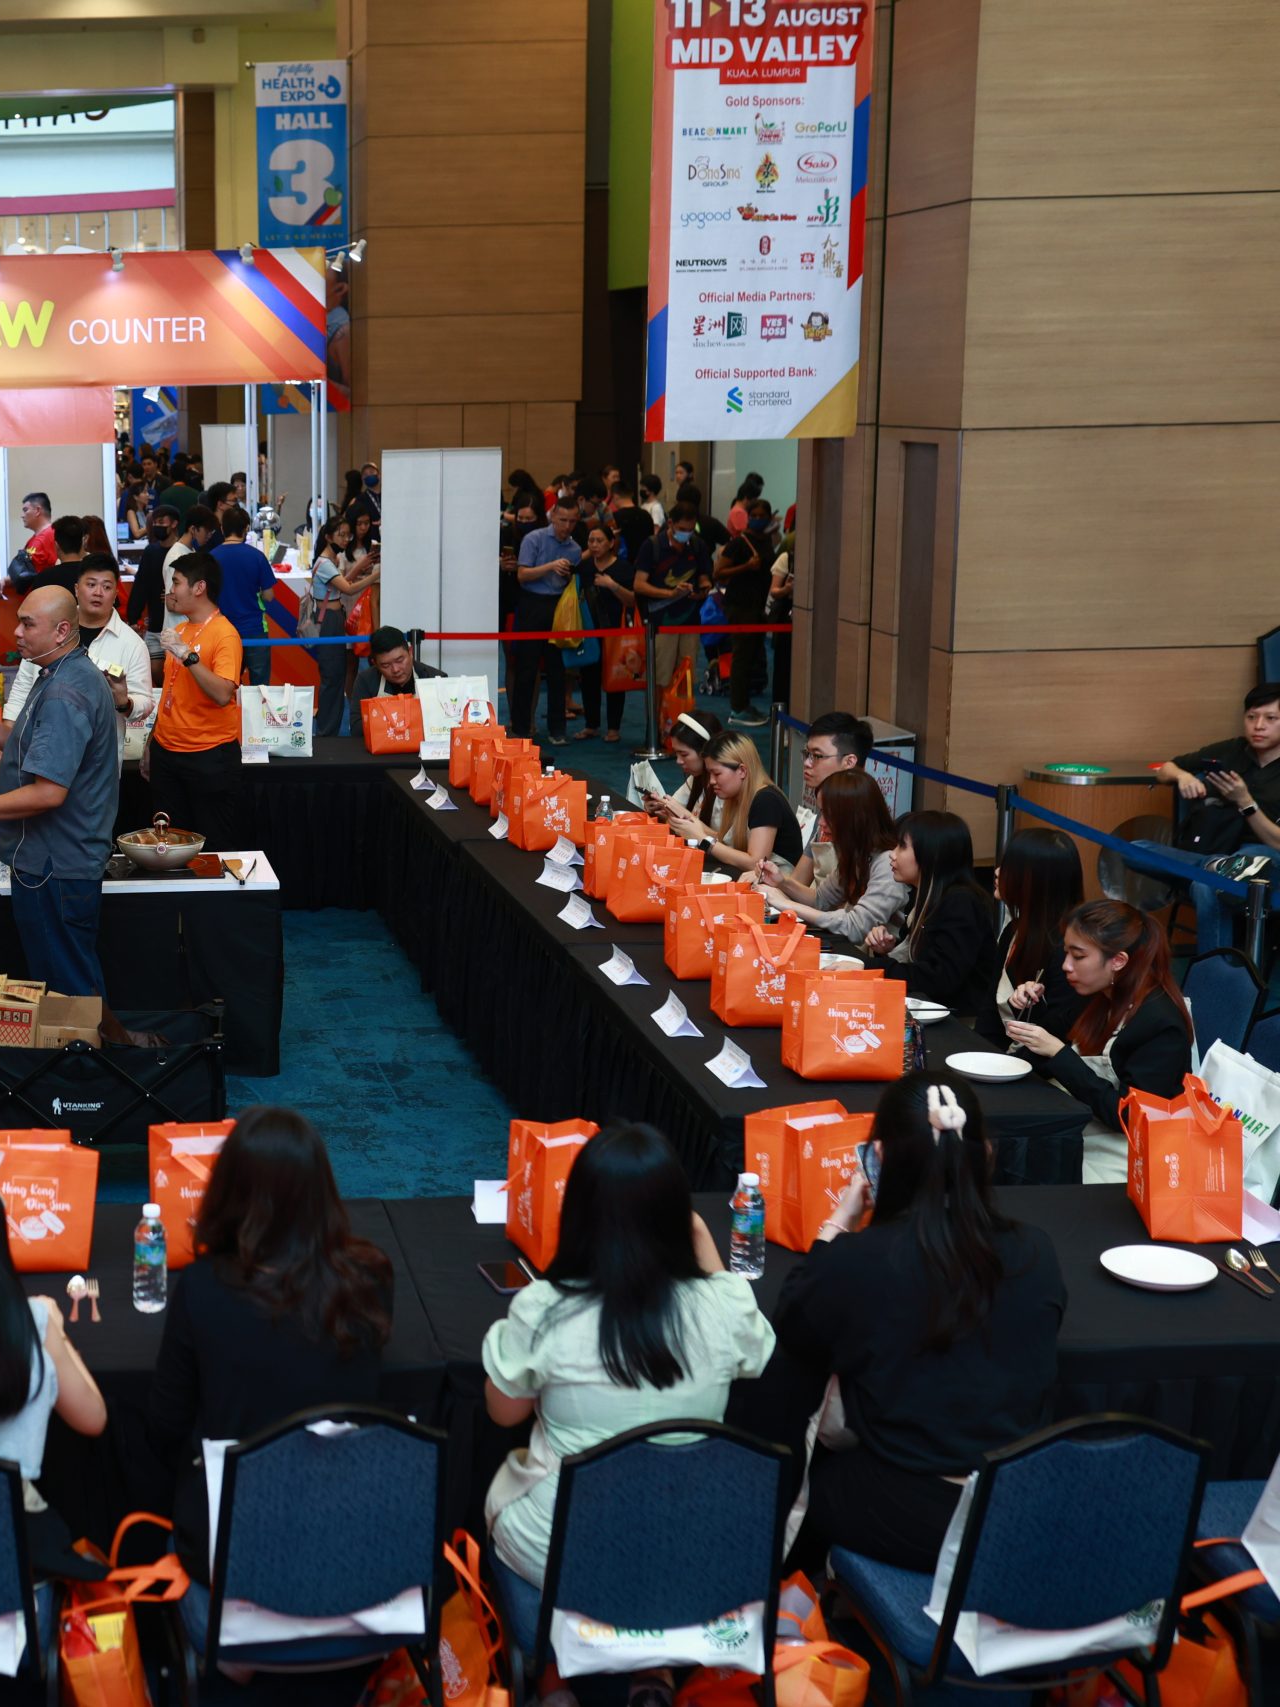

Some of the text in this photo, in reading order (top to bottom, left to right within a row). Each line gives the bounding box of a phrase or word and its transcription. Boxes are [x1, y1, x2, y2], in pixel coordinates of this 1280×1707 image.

[674, 0, 862, 28] 11 13 AUGUST
[671, 35, 858, 64] MID VALLEY
[726, 68, 801, 78] KUALA LUMPUR
[261, 78, 315, 90] HEALTH
[280, 91, 316, 102] EXPO
[725, 95, 805, 110] Gold Sponsors:
[275, 112, 333, 130] HALL
[268, 138, 343, 226] 3
[680, 207, 732, 229] yogood
[698, 290, 816, 304] Official Media Partners:
[765, 318, 783, 327] YES
[68, 317, 206, 345] COUNTER
[761, 327, 787, 337] BOSS
[695, 366, 817, 380] Official Supported Bank:
[748, 391, 790, 400] standard
[748, 398, 793, 407] chartered
[827, 1008, 873, 1020] Hong Kong
[847, 1020, 886, 1030] Dim Sum
[821, 1156, 842, 1170] Hong
[1, 1181, 56, 1198] Hong Kong
[24, 1199, 72, 1212] Dim Sum
[726, 1631, 751, 1651] FARM
